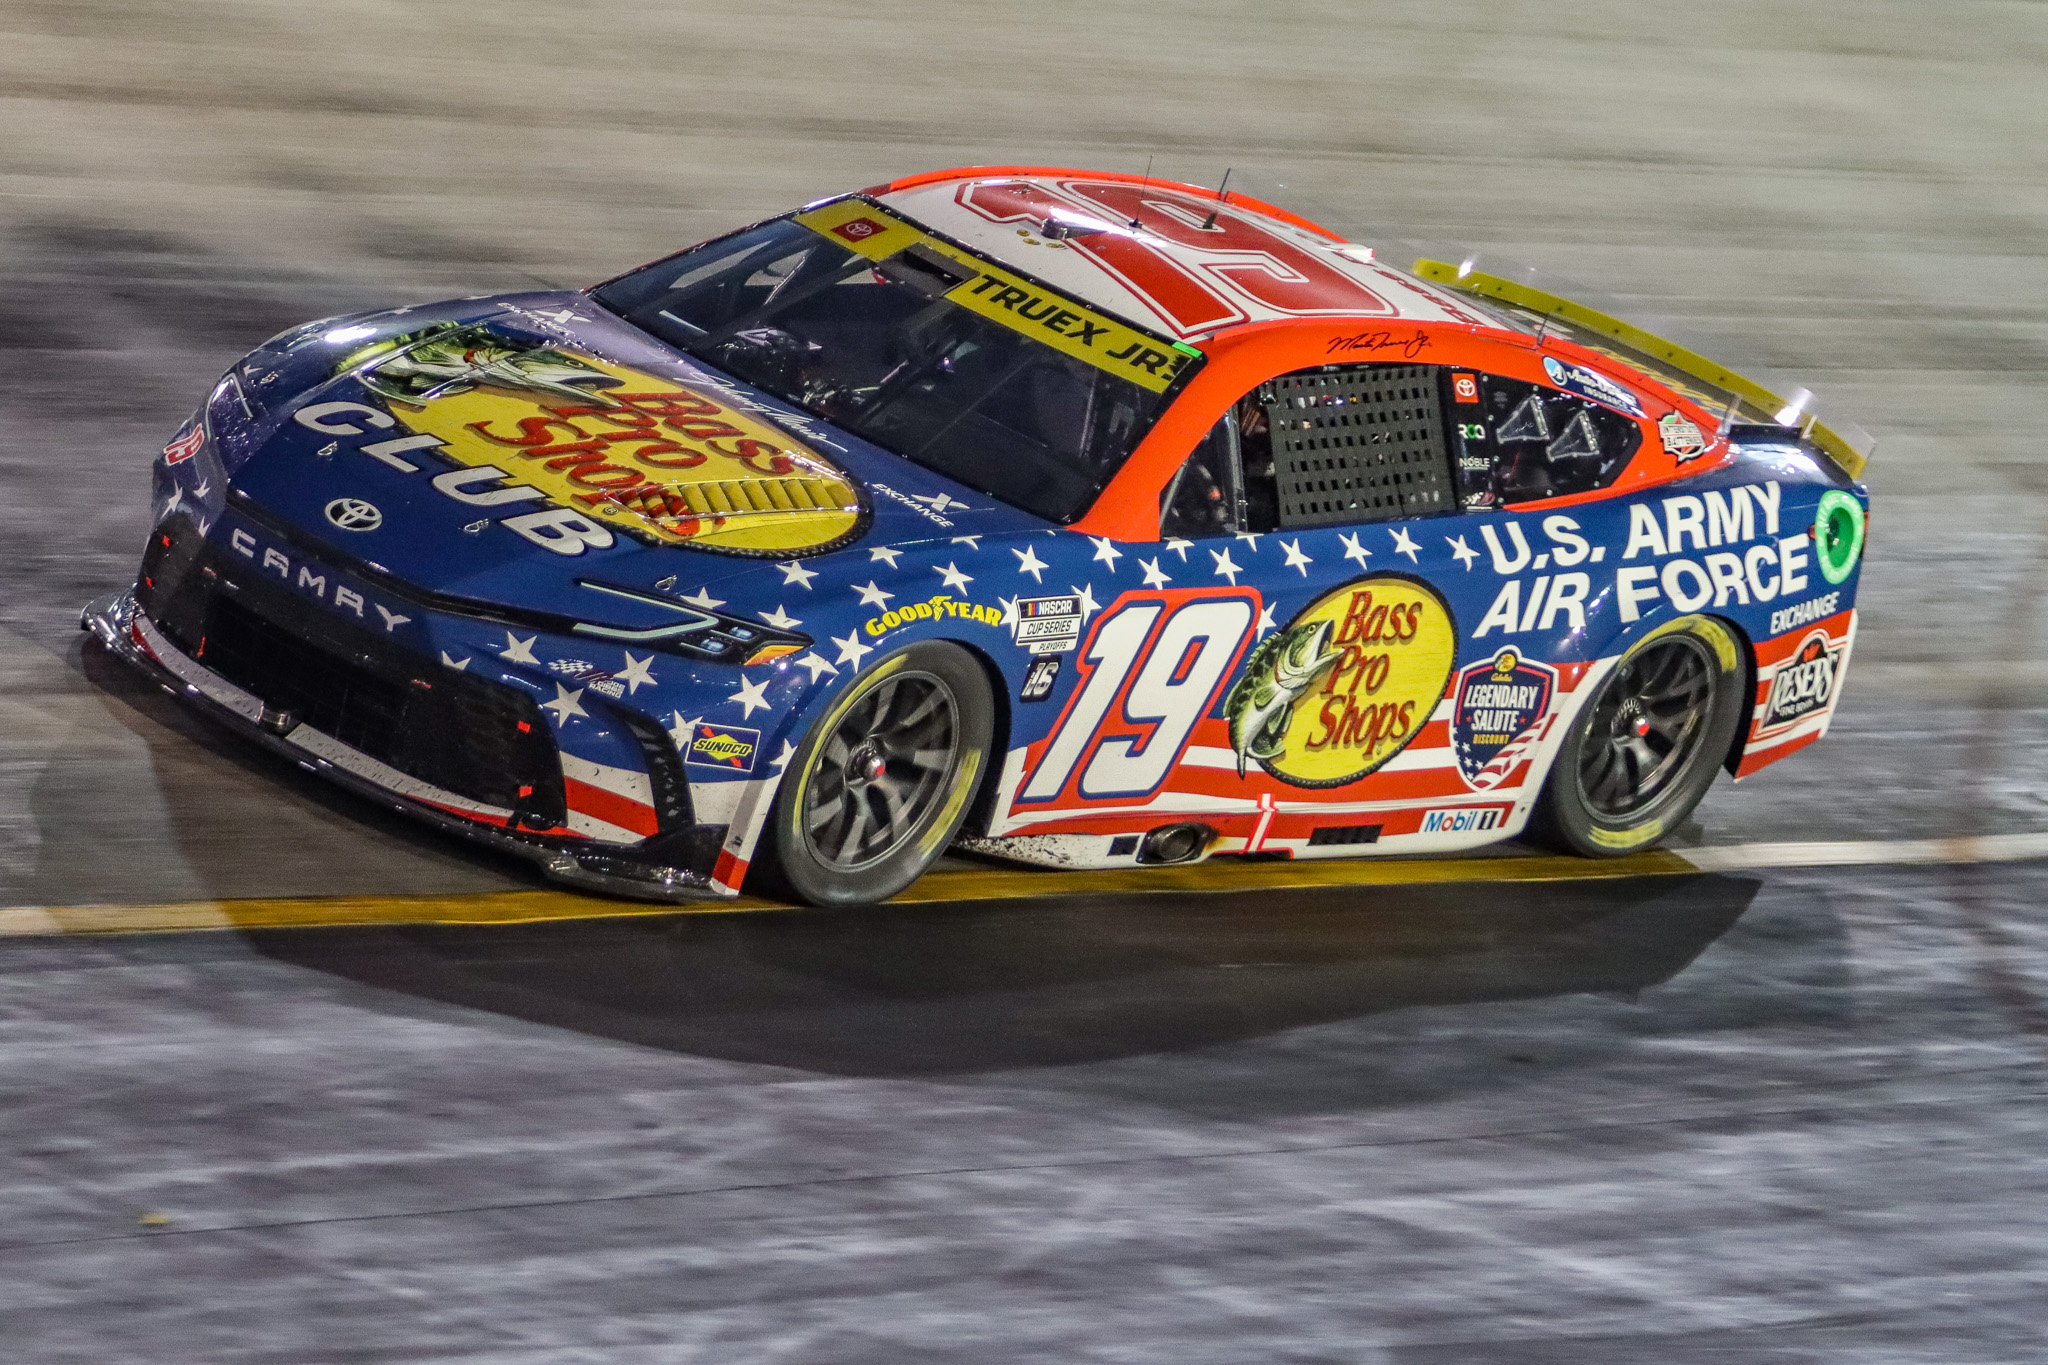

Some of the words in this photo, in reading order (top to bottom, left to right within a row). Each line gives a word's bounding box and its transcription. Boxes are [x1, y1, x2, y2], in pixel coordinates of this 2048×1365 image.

[970, 273, 1111, 348] TRUEX
[1104, 339, 1176, 382] JR.
[540, 403, 709, 469] Pro
[602, 390, 796, 476] Bass
[293, 400, 615, 556] CLUB
[464, 415, 727, 542] Shops
[870, 483, 955, 528] EXCHANGE
[1480, 515, 1605, 575] U.S.
[1623, 480, 1783, 559] ARMY
[231, 527, 412, 633] CAMRY
[1471, 566, 1592, 639] AIR
[1617, 533, 1810, 623] FORCE
[1026, 622, 1044, 635] CUP
[1044, 620, 1073, 634] SERIES
[1038, 600, 1073, 616] NASCAR
[1333, 590, 1423, 646] Bass
[1769, 592, 1841, 635] EXCHANGE
[1038, 641, 1068, 651] PLAYOFFS
[1320, 645, 1390, 695] Pro
[1021, 662, 1060, 696] 16
[1021, 602, 1253, 800] 19
[1463, 684, 1540, 709] LEGENDARY
[1304, 694, 1416, 757] Shops
[1471, 709, 1520, 732] SALUTE
[1472, 733, 1510, 745] DISCOUNT
[695, 739, 752, 756] SUNOCO
[1424, 811, 1478, 833] Mobil
[1478, 811, 1499, 831] 1
